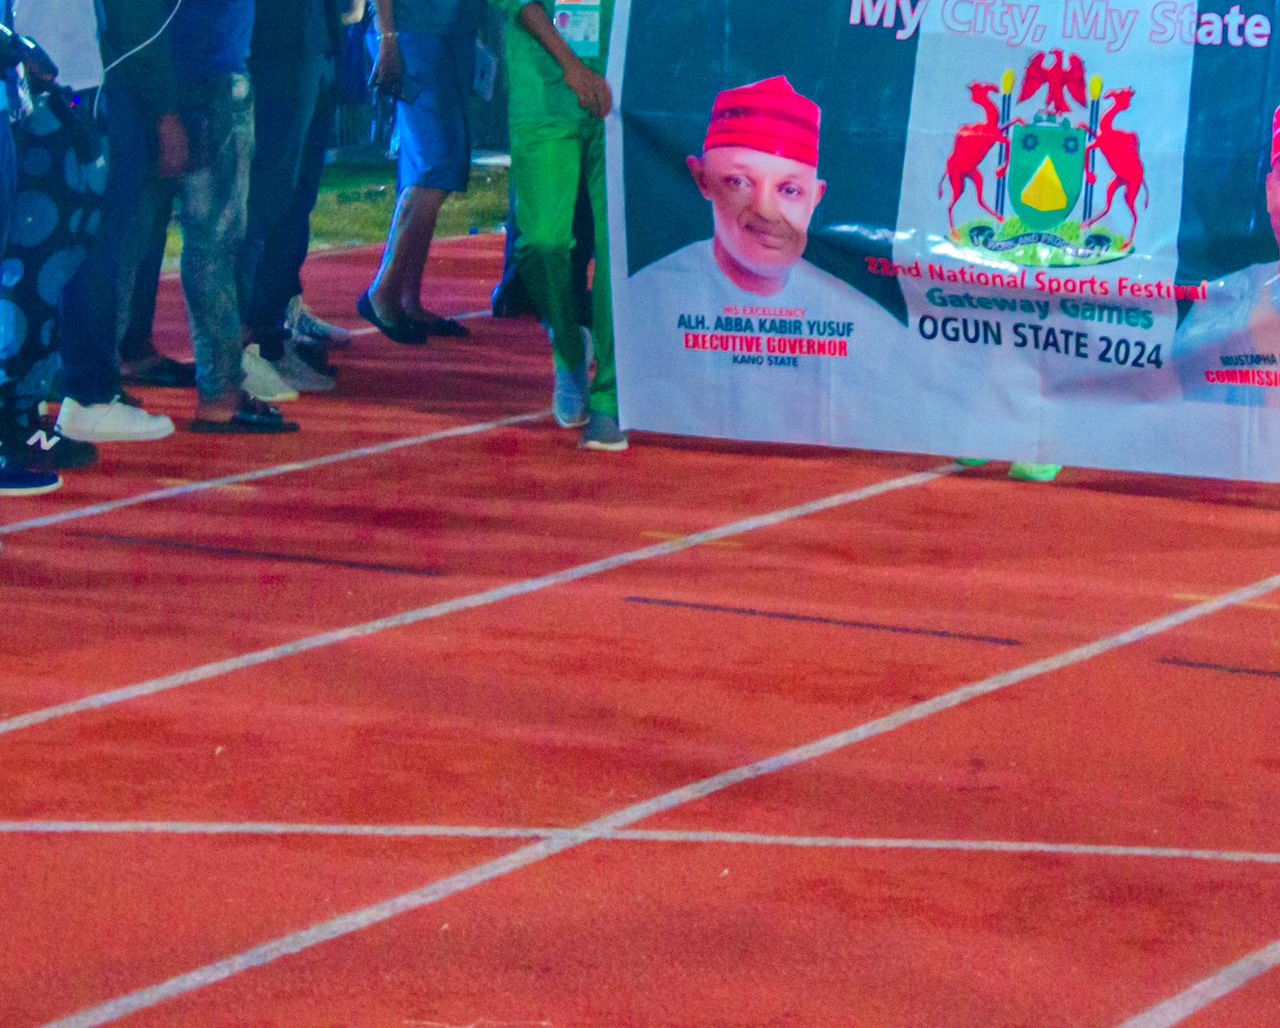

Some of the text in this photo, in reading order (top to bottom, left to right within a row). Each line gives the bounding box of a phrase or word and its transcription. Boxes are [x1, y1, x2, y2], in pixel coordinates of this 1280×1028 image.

[1149, 0, 1272, 48] State
[865, 256, 1208, 302] 22nd National Sports Festival
[723, 306, 807, 319] HIS EXCELLENCY
[926, 287, 1155, 330] Gateway Games
[677, 314, 855, 337] ALH. ABBA KABIR YUSUF
[684, 333, 848, 358] EXECUTIVE GOVERNOR
[918, 314, 1164, 370] OGUN STATE 2024
[732, 355, 798, 367] KANO STATE
[1221, 353, 1277, 367] MUSTAPHA
